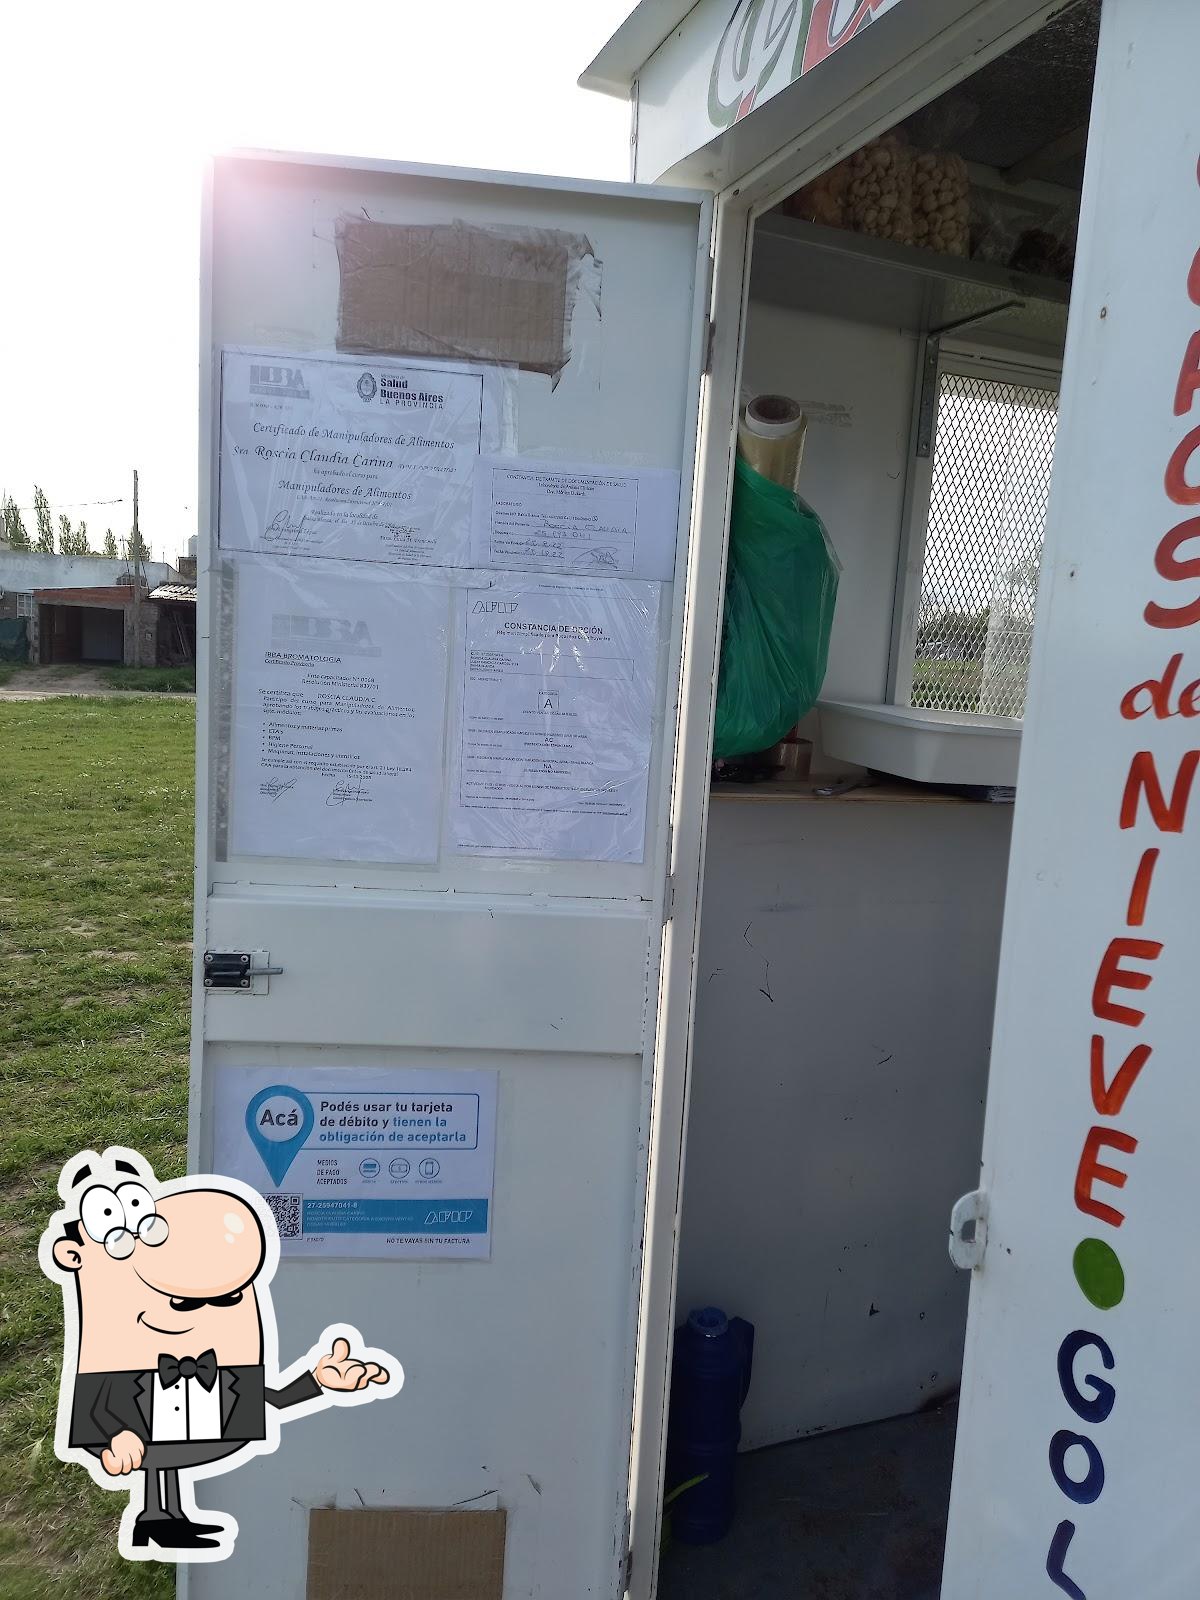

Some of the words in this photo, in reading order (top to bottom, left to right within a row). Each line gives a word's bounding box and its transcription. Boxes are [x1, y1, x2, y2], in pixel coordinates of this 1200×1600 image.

[380, 378, 408, 389] Salud
[380, 389, 417, 401] Buenos
[418, 392, 444, 403] Aires
[395, 400, 444, 410] PROVINCIA
[253, 422, 306, 437] Certificado
[308, 427, 320, 438] de
[322, 429, 393, 444] Manipuladores
[394, 434, 406, 445] de
[406, 436, 455, 450] Alimentos
[254, 446, 296, 460] Roscia
[300, 448, 349, 464] Claudia
[352, 452, 394, 468] Carina
[278, 480, 350, 496] Manipuladores
[352, 484, 363, 495] de
[364, 486, 414, 500] Alimentos
[504, 622, 557, 632] CONSTANCIA
[558, 625, 570, 633] DE
[571, 625, 603, 635] OPCIÓN
[543, 698, 553, 709] A
[1074, 750, 1200, 1228] NIEVE
[320, 1101, 360, 1112] Podés
[363, 1103, 391, 1112] usar
[394, 1102, 408, 1112] tu
[411, 1102, 453, 1114] tarjeta
[259, 1108, 299, 1127] Acá
[319, 1116, 335, 1127] de
[339, 1115, 379, 1127] débito
[381, 1119, 389, 1130] y
[393, 1116, 432, 1127] tienen
[435, 1116, 447, 1127] la
[319, 1131, 385, 1145] obligación
[388, 1131, 404, 1142] de
[407, 1131, 467, 1145] aceptarla
[317, 1159, 338, 1167] MEDIOS
[423, 1211, 473, 1225] AFIP
